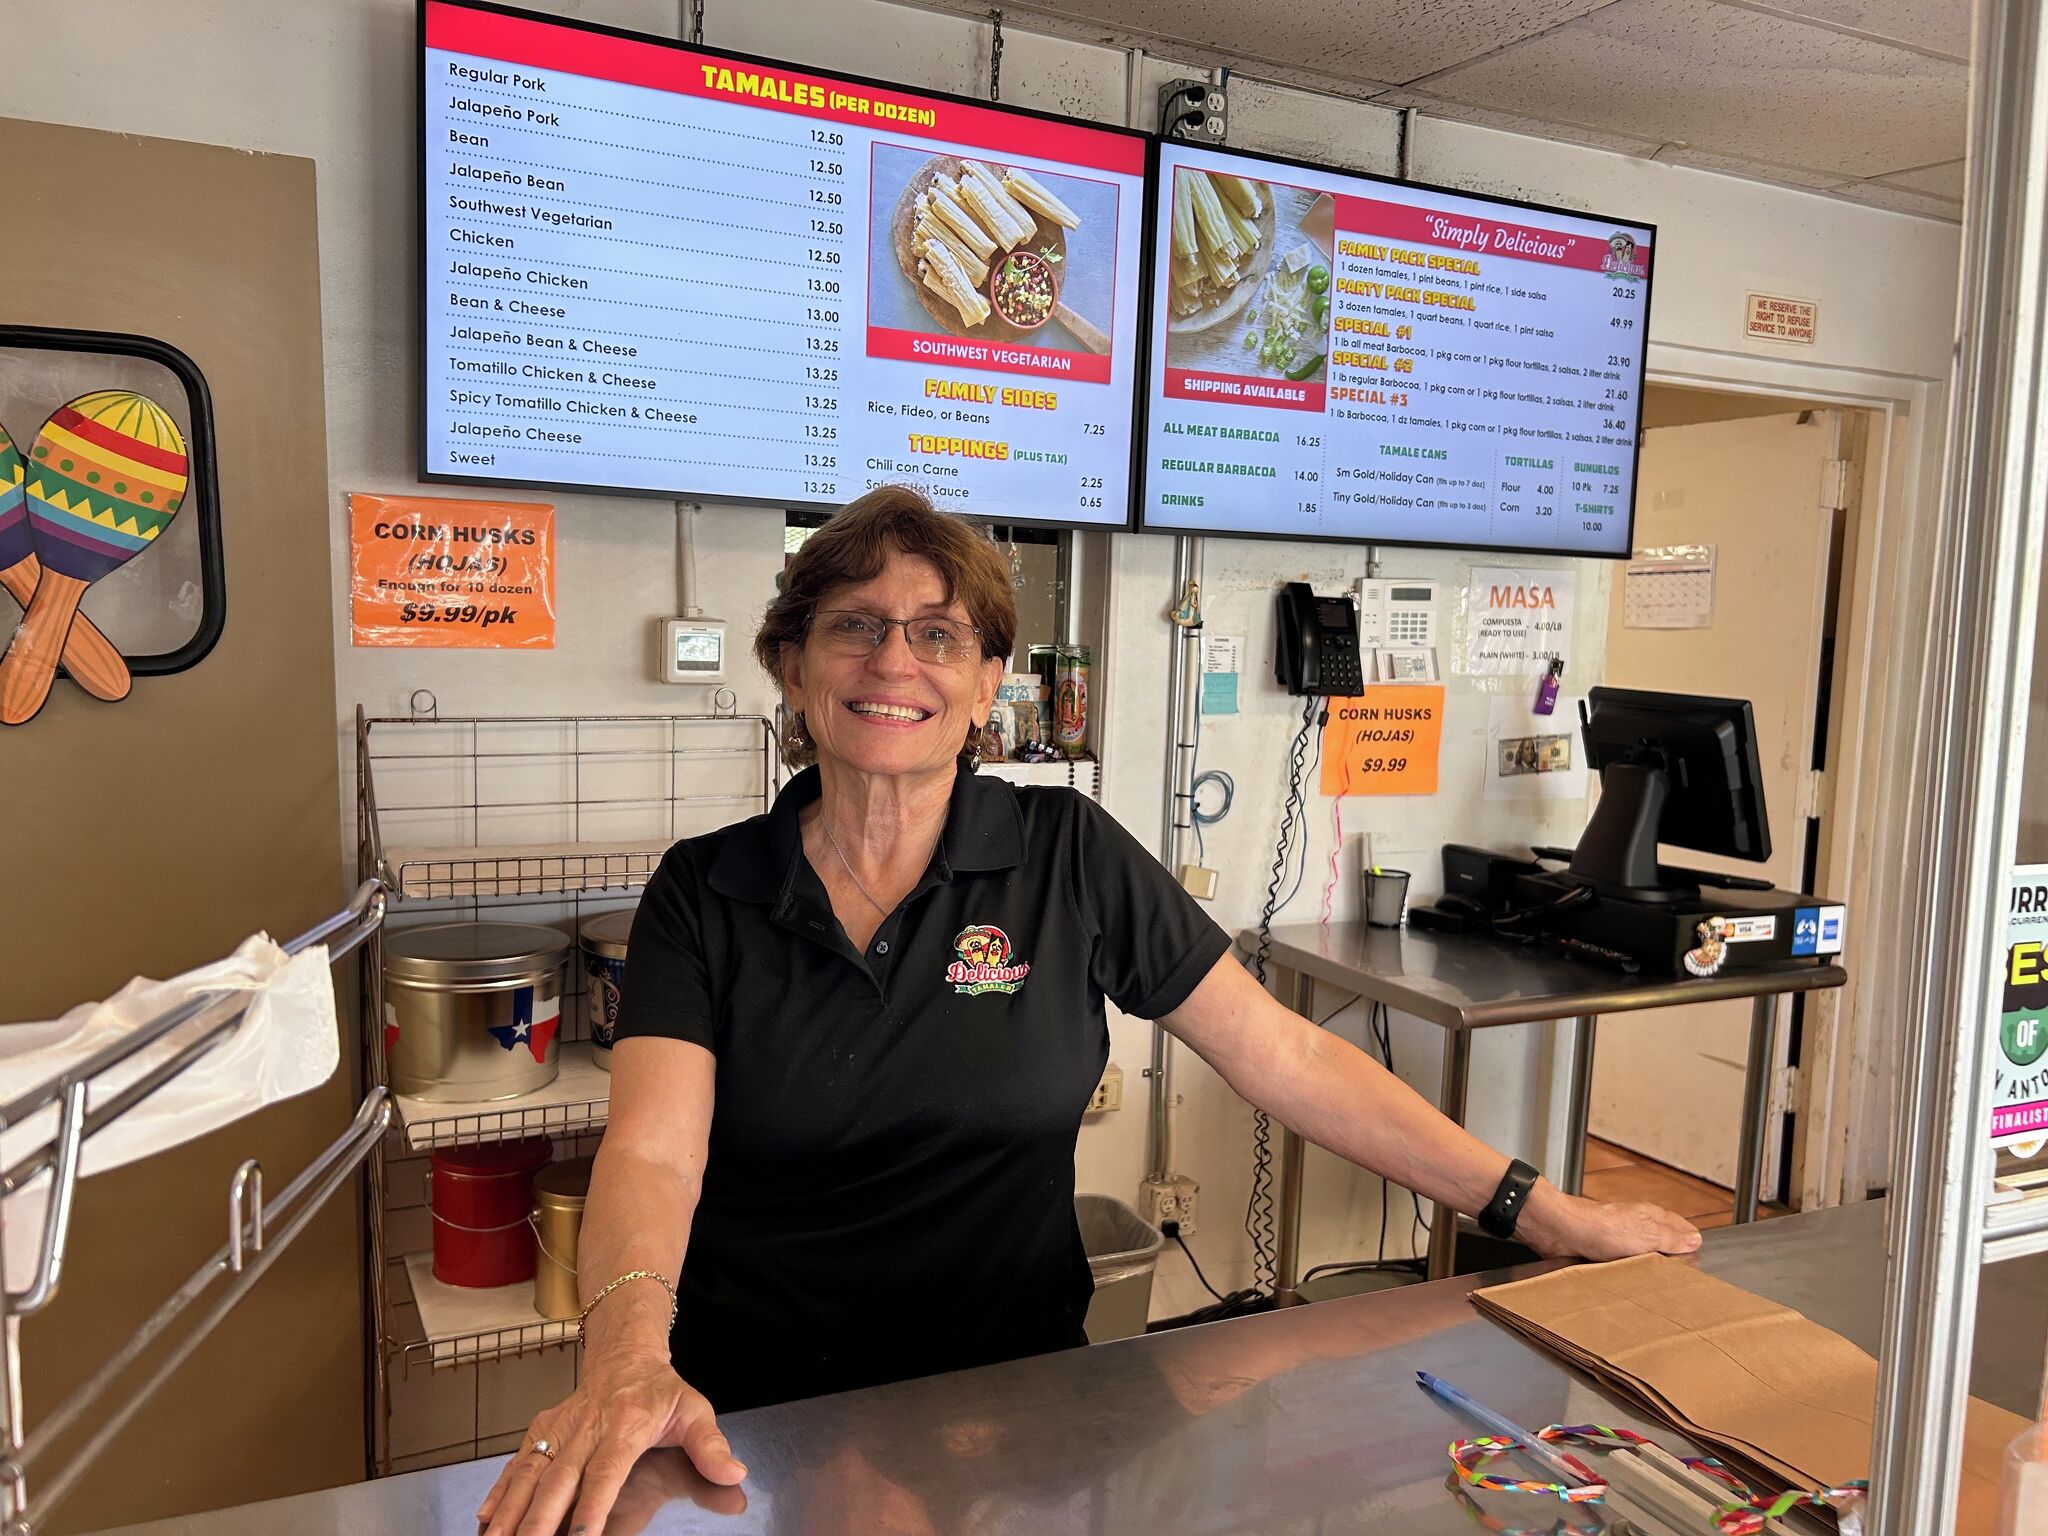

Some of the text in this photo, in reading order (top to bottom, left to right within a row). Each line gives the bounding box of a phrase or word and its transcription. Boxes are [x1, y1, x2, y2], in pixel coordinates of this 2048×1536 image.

[450, 63, 546, 92] Regular Pork
[700, 64, 937, 129] TAMALES (PER DOZEN)
[449, 96, 559, 126] Jalapeño Pork
[450, 130, 488, 147] Bean
[811, 130, 843, 146] 12.50
[810, 160, 842, 175] 12.50
[449, 163, 564, 191] Jalapeño Bean
[810, 190, 841, 205] 12.50
[450, 196, 612, 230] Southwest Vegetarian
[811, 220, 842, 235] 12.50
[450, 229, 514, 248] Chicken
[808, 249, 840, 264] 12.50
[1338, 239, 1481, 276] FAMILY PACK SPECIAL
[450, 261, 588, 289] Jalapeño Chicken
[808, 279, 839, 293] 13.00
[1612, 287, 1635, 300] 20.25
[1336, 278, 1477, 311] PARTY PACK SPECIAL
[451, 293, 565, 318] Bean & Cheese
[1757, 300, 1811, 316] WE RESERVE THE
[808, 308, 839, 323] 13.00
[1756, 311, 1811, 327] RIGHT TO REFUSE
[1334, 316, 1413, 340] SPECIAL #1
[1610, 317, 1633, 330] 49.99
[1749, 322, 1812, 338] SERVICE TO ANYONE
[450, 326, 637, 357] Jalapeño Bean & Cheese
[807, 338, 838, 352] 13.25
[912, 339, 1071, 371] SOUTHWEST VEGETARIAN
[1332, 351, 1414, 373] SPECIAL #2
[1607, 356, 1631, 367] 23.90
[450, 358, 656, 389] Tomatillo Chicken & Cheese
[806, 367, 837, 381] 13.25
[924, 378, 1058, 411] FAMILY SIDES
[1184, 378, 1306, 402] SHIPPING AVAILABLE
[1330, 387, 1408, 407] SPECIAL #3
[1605, 389, 1628, 400] 21.60
[450, 390, 697, 423] Spicy Tomatillo Chicken & Cheese
[806, 397, 837, 410] 13.25
[867, 401, 990, 424] Rice, Fideo, or Beans
[449, 421, 582, 443] Jalapeño Cheese
[1084, 424, 1105, 435] 7.25
[1603, 419, 1625, 430] 36.40
[805, 426, 836, 439] 13.25
[1163, 422, 1280, 443] ALL MEAT BARBACOA
[1295, 435, 1321, 447] 16.25
[908, 433, 1067, 465] TOPPINGS (PLUS TAX)
[1379, 444, 1448, 460] TAMALE CANS
[450, 451, 495, 465] Sweet
[805, 455, 836, 467] 13.25
[1505, 456, 1553, 469] TORTILLAS
[867, 458, 958, 476] Chili con Carne
[1161, 459, 1277, 478] REGULAR BARBACOA
[1081, 477, 1102, 488] 2.25
[1294, 470, 1319, 482] 14.00
[1336, 468, 1434, 484] Sm Gold/Holiday Can
[804, 482, 835, 494] 13.25
[933, 484, 970, 498] Sauce
[1501, 482, 1553, 495] Flour 4.00
[1572, 482, 1619, 494] 10 Pk 7.25
[1080, 497, 1101, 507] 0.65
[1161, 494, 1204, 506] DRINKS
[1297, 502, 1317, 513] 1.85
[1333, 492, 1434, 509] Tiny Gold/Holiday Can
[1500, 502, 1552, 516] Corn 3.20
[1575, 503, 1614, 515] T-SHIRTS
[1582, 521, 1602, 531] 10.00
[374, 523, 536, 545] CORN HUSKS
[408, 553, 508, 576] (HOJAS)
[440, 581, 461, 592] for
[467, 582, 484, 593] 10
[489, 583, 533, 595] dozen
[1489, 585, 1555, 609] MASA
[400, 602, 518, 627] $9.99/pk
[1482, 618, 1522, 626] COMPUESTA
[1478, 630, 1501, 638] (READY
[1512, 630, 1527, 638] USE)
[1534, 622, 1562, 632] 4.00/LB
[1479, 651, 1498, 659] PLAIN
[1500, 651, 1525, 660] (WHITE)
[1339, 708, 1432, 720] CORN HUSKS
[1356, 730, 1415, 744] (HOJAS)
[1362, 758, 1407, 773] $9.99
[945, 960, 1031, 983] Delicious
[2016, 1019, 2039, 1048] OF
